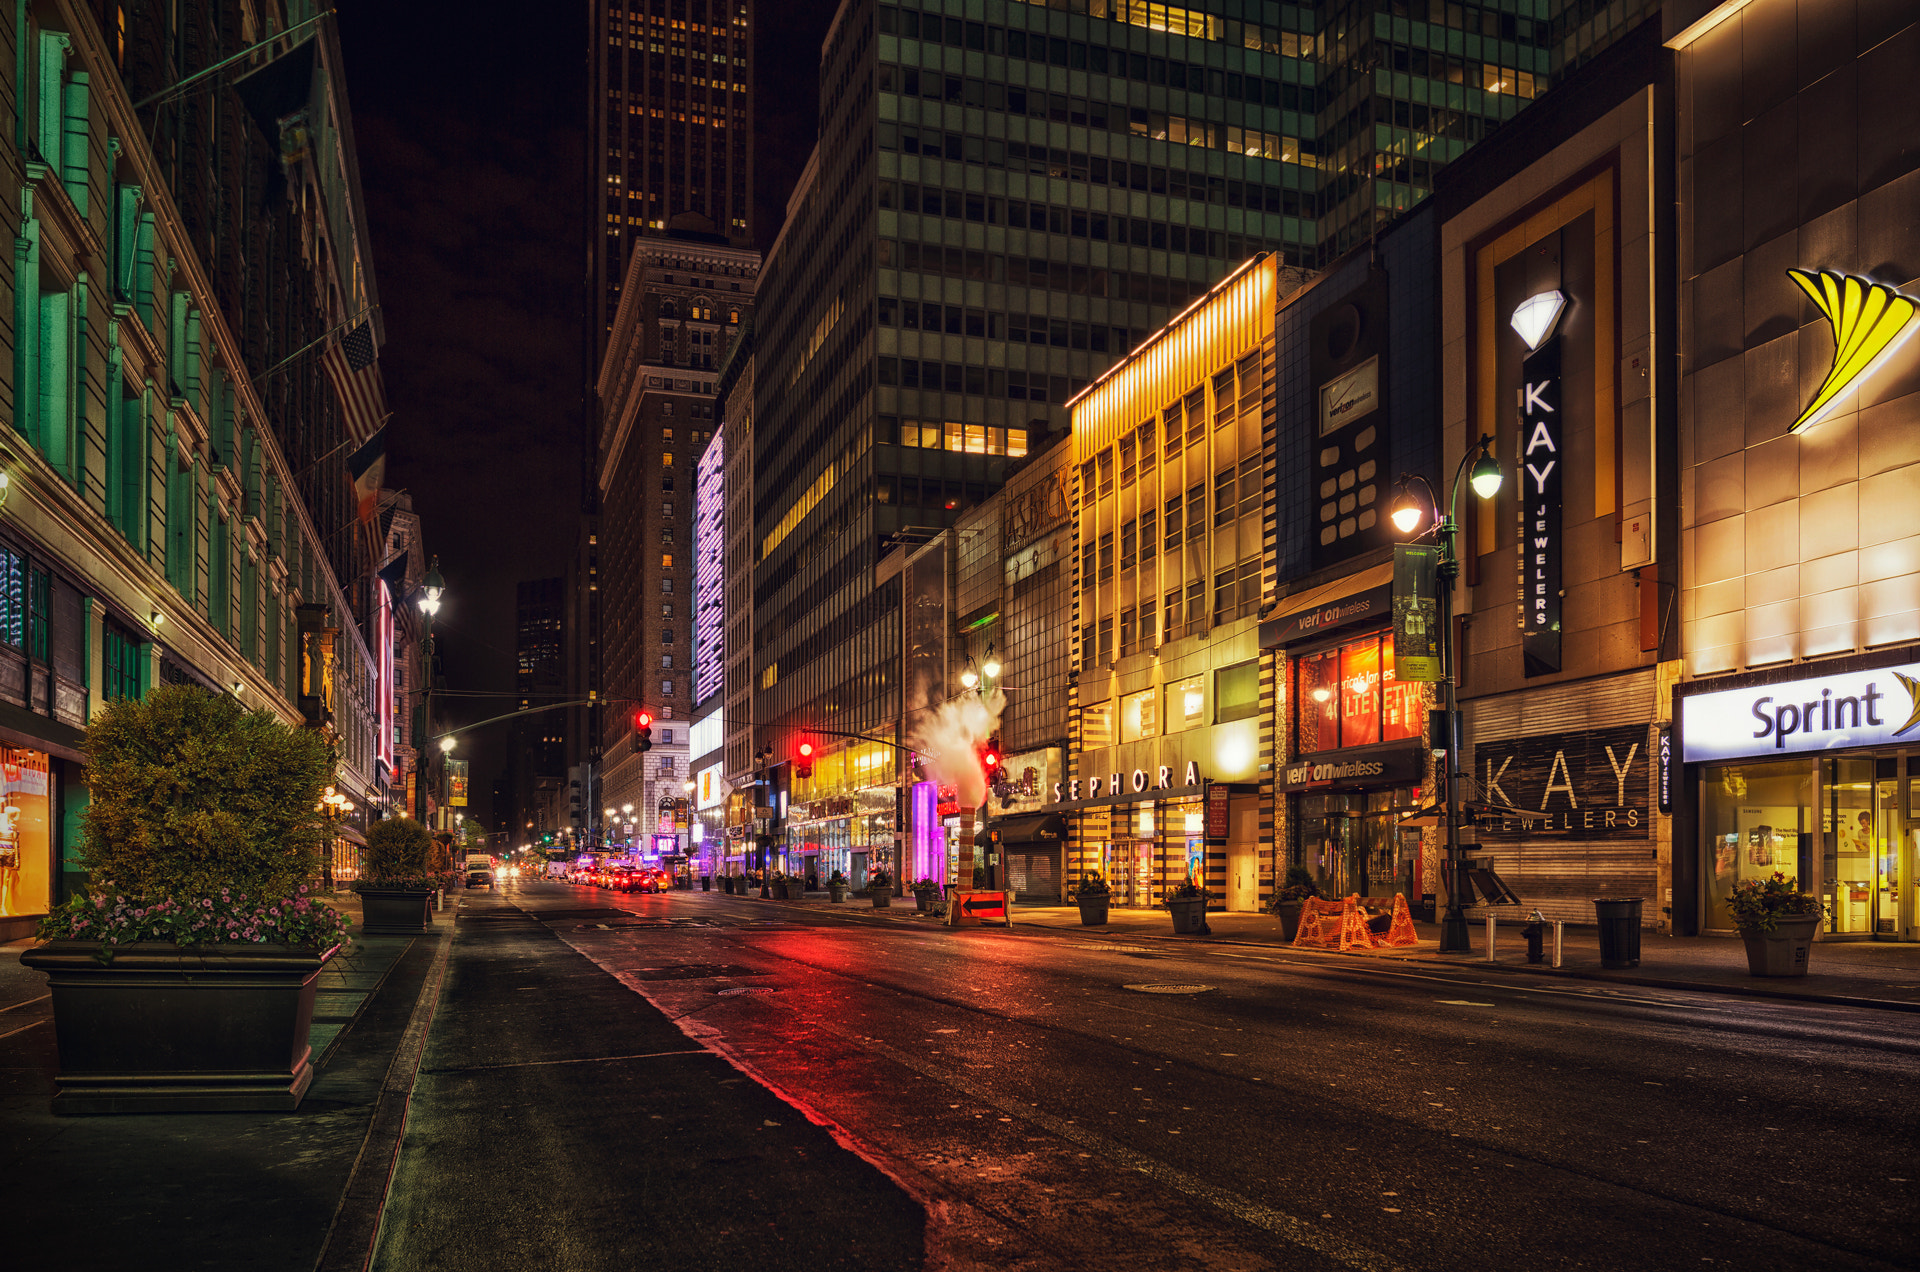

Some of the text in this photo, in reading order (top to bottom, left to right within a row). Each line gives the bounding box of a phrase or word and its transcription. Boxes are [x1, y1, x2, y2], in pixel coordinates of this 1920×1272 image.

[1525, 379, 1556, 624] KAY JEWELERS
[1346, 692, 1370, 717] LTE
[1751, 682, 1884, 748] Sprint
[1661, 736, 1671, 766] KAY
[1054, 760, 1201, 804] SEPHORA
[1486, 743, 1639, 811] KAY
[1484, 809, 1639, 832] JEWELERS
